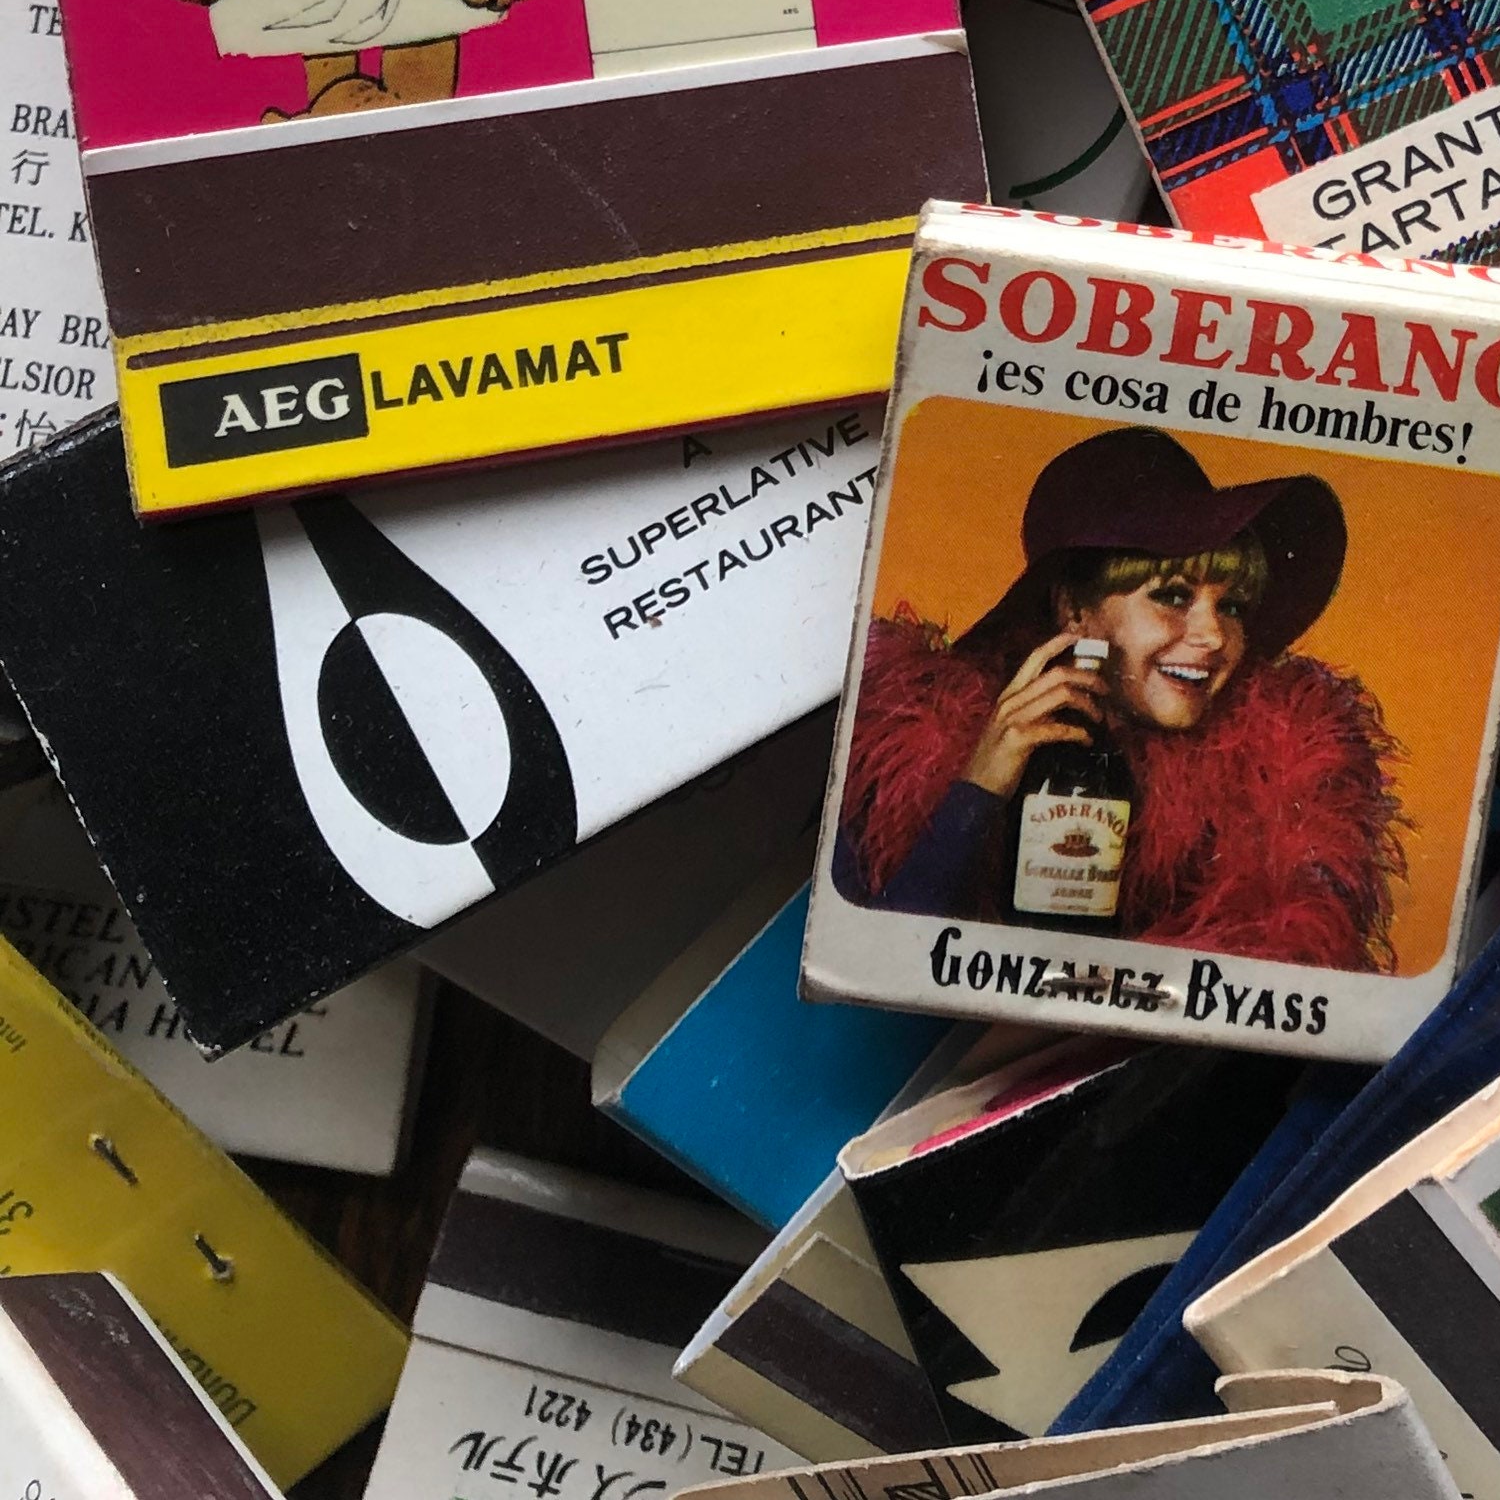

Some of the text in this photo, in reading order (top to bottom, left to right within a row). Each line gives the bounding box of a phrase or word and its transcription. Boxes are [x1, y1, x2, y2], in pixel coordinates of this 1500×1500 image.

[11, 103, 76, 140] BRA
[12, 149, 50, 187] 行
[0, 308, 110, 350] AY BR
[0, 356, 95, 400] LSIOR
[214, 332, 630, 439] AEG LAVAMAT
[1064, 362, 1168, 414] cosa
[1187, 380, 1241, 423] de
[1259, 399, 1475, 465] hombres!
[680, 436, 711, 469] A
[580, 412, 869, 587] SUPERLATIVE
[603, 465, 879, 640] RESTAURANT
[0, 895, 125, 944] STEL
[524, 1386, 591, 1431] 4221
